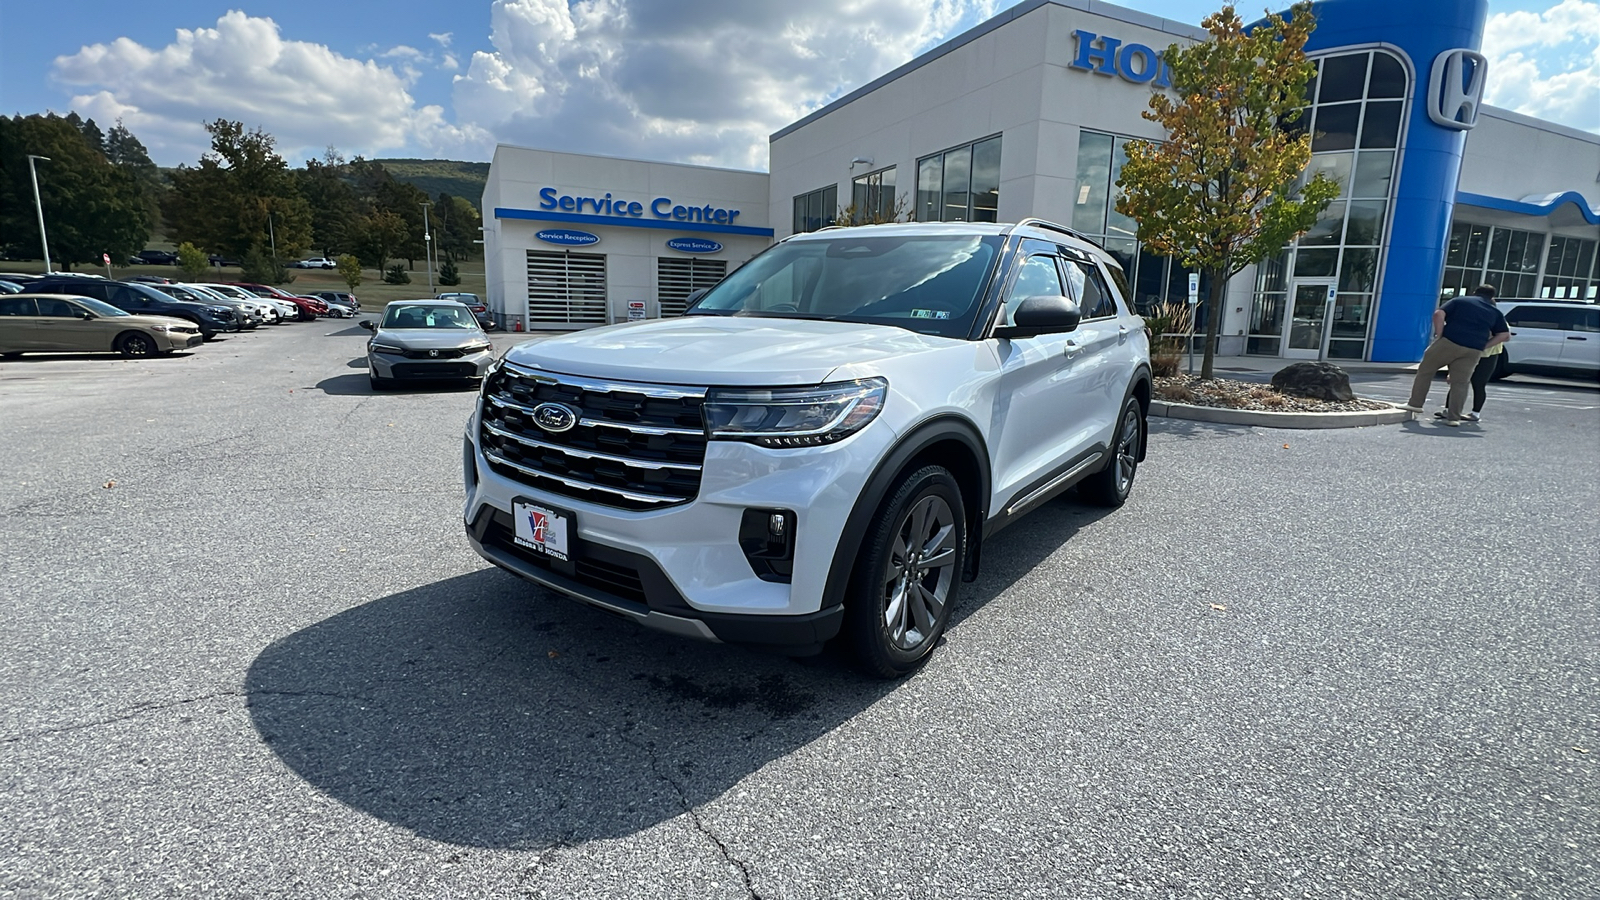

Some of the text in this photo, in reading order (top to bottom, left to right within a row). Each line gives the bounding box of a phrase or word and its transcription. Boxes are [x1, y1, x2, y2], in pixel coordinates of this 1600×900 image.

[539, 187, 740, 225] Service Center
[539, 232, 596, 242] Service Reception
[669, 240, 691, 249] Express
[539, 407, 563, 426] Ford
[545, 548, 568, 561] HONDA
